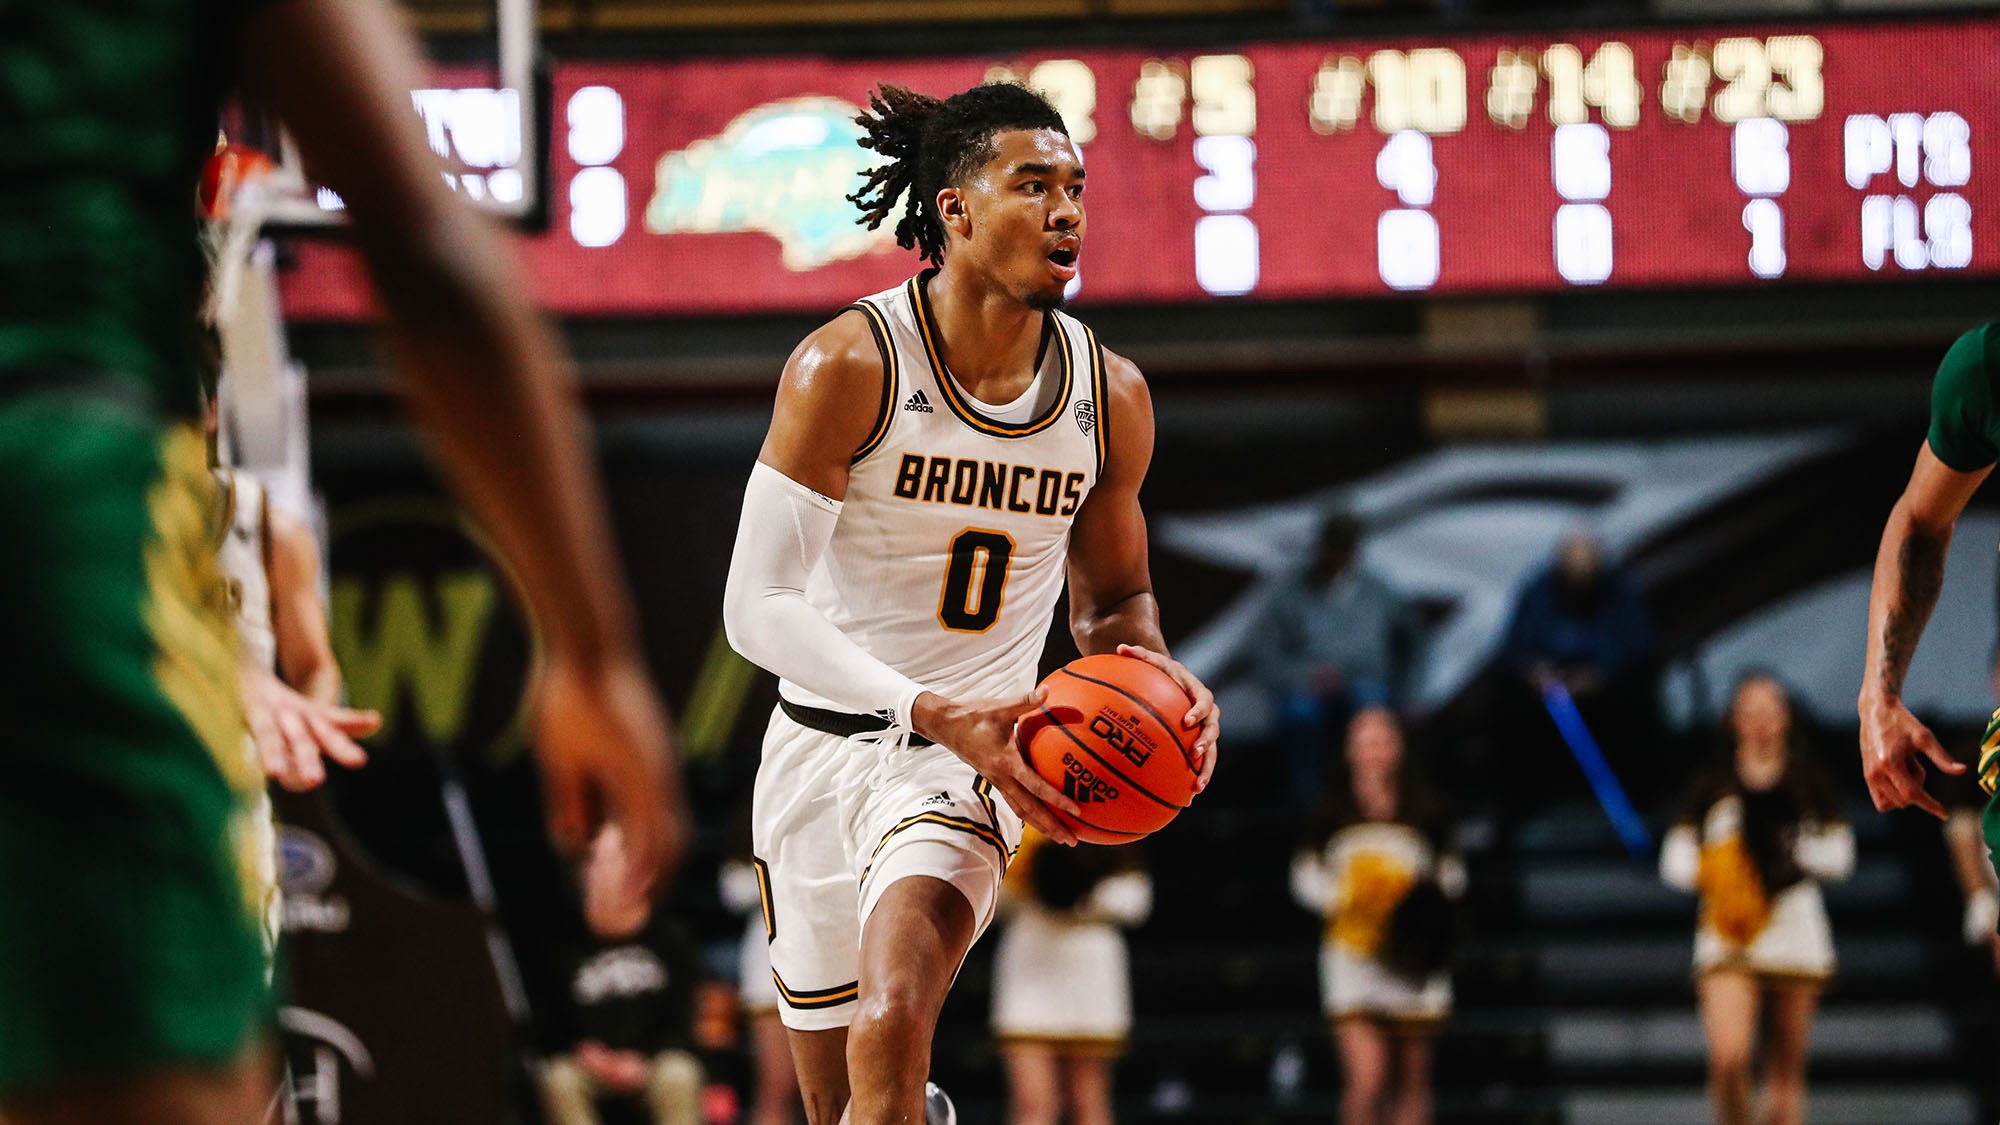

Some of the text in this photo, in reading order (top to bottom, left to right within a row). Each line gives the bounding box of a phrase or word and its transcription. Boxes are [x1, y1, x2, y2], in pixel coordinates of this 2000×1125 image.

[1310, 47, 1467, 135] #10
[1486, 41, 1643, 129] #14
[1658, 35, 1824, 124] #23
[1844, 111, 1972, 189] PTS
[1742, 198, 1786, 279] 1
[1861, 192, 1973, 271] FLS
[904, 403, 934, 413] adidas
[892, 451, 1085, 517] BRONCOS
[936, 525, 1016, 634] 0
[1062, 752, 1119, 799] adidas
[1090, 715, 1150, 768] PRO
